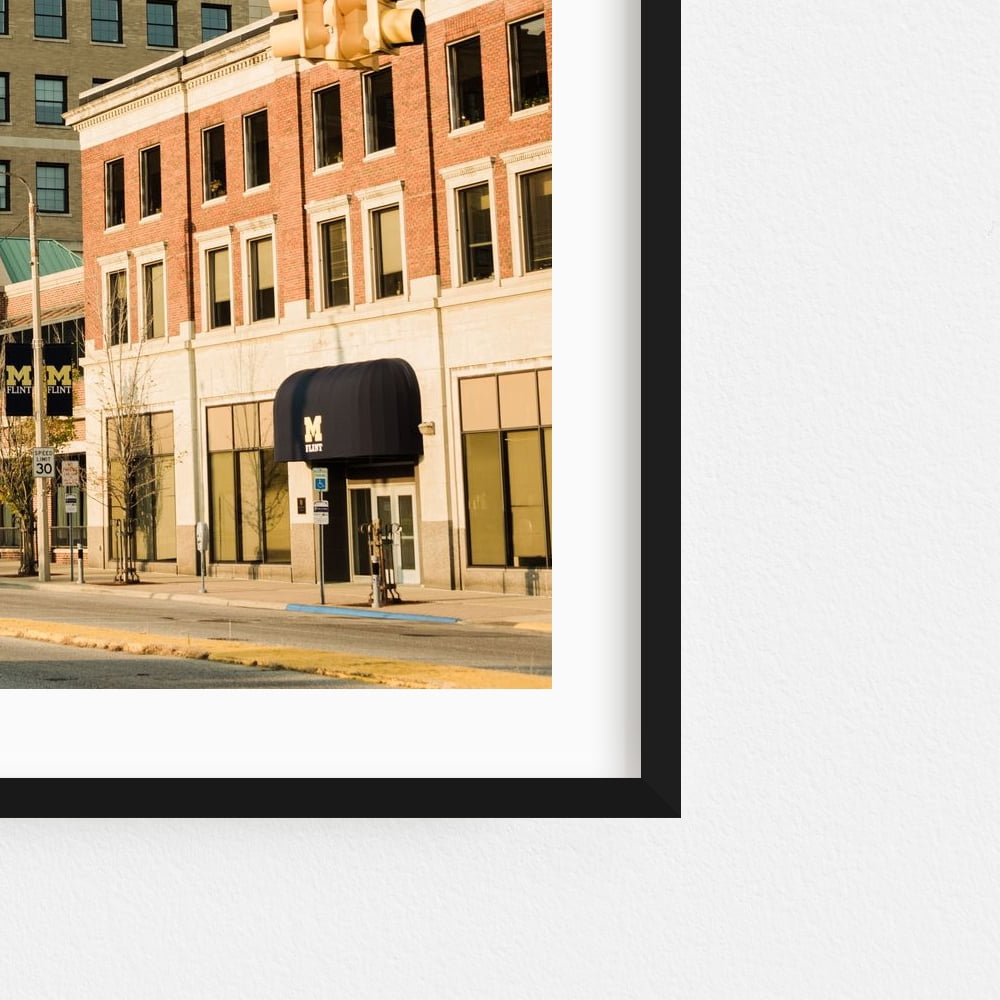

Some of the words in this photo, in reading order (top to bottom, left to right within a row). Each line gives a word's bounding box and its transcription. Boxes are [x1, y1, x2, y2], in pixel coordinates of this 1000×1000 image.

[6, 365, 32, 386] M
[46, 365, 72, 386] M
[6, 385, 32, 394] FLINT
[47, 385, 72, 394] FLINT
[303, 415, 323, 443] M
[304, 443, 323, 454] FLINT
[36, 462, 52, 475] 30
